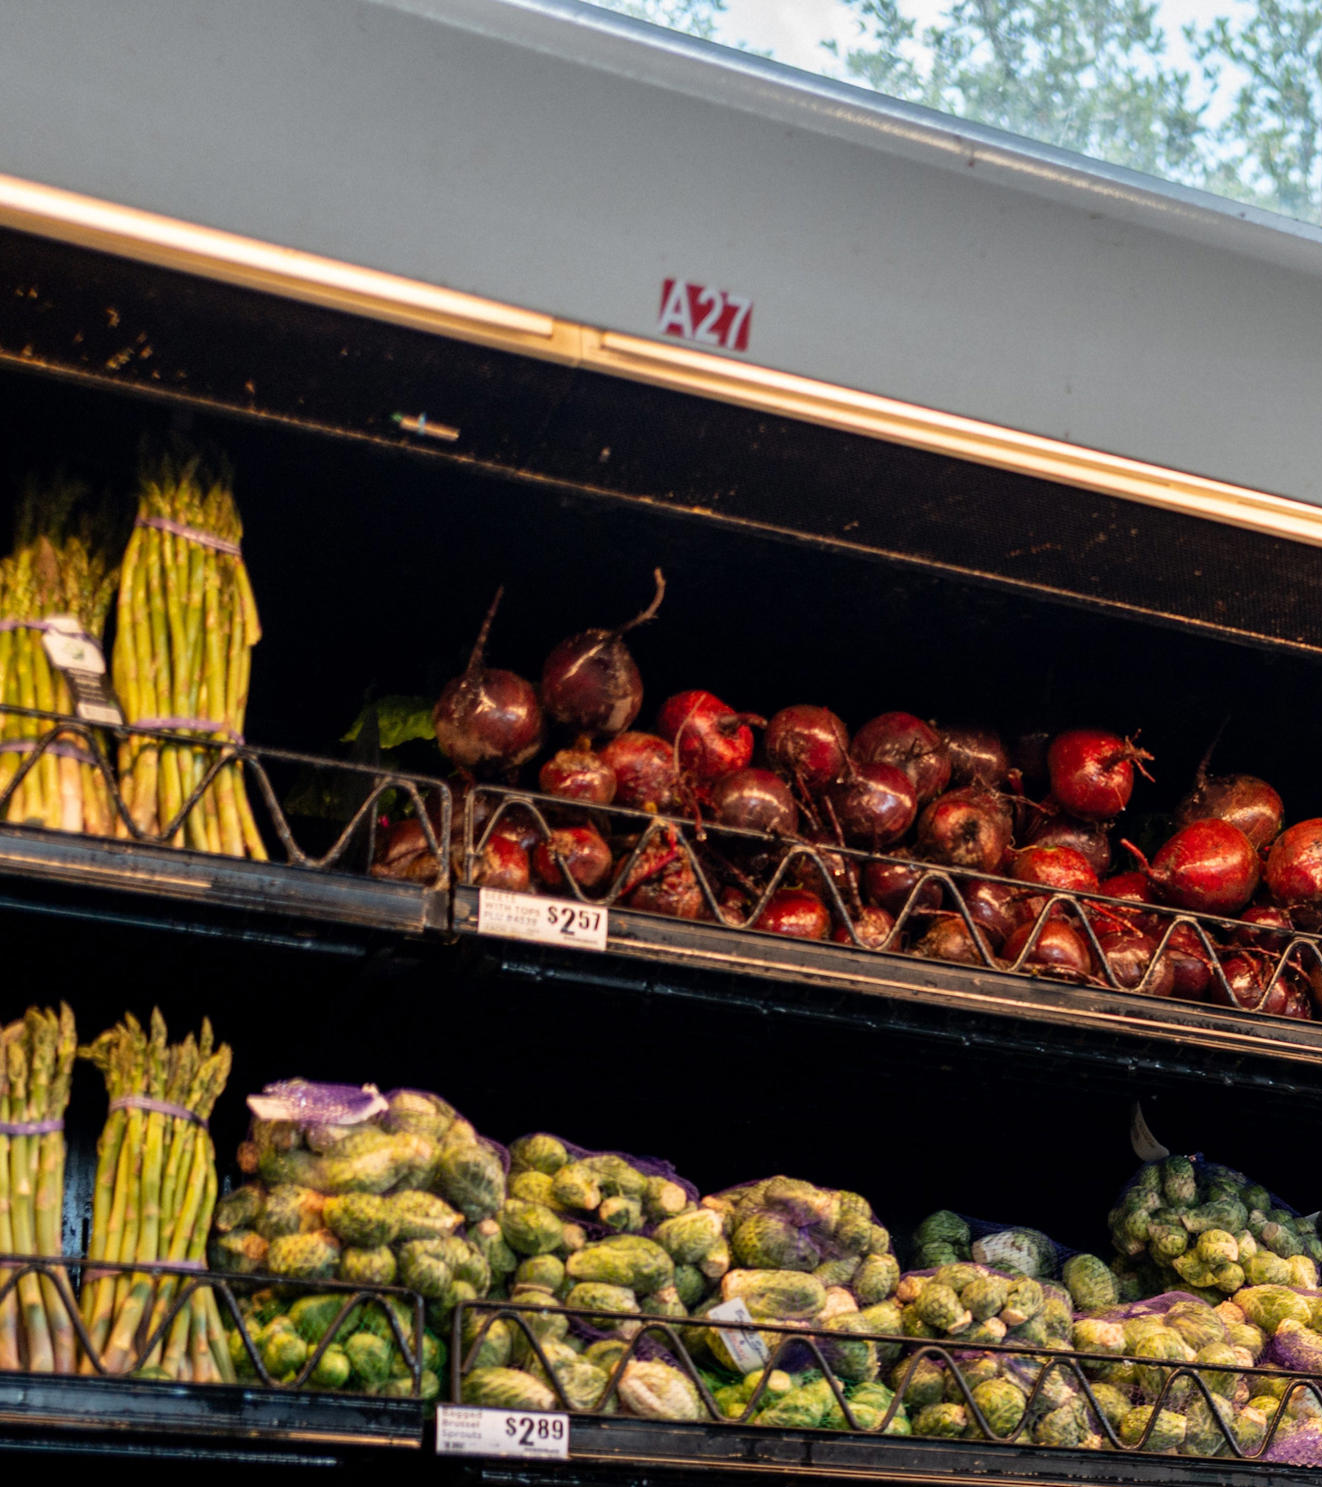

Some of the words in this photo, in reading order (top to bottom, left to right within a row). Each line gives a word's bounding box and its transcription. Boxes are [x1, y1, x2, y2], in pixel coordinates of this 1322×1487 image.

[658, 280, 752, 350] A27
[547, 905, 601, 936] $257
[505, 1416, 564, 1447] $289
